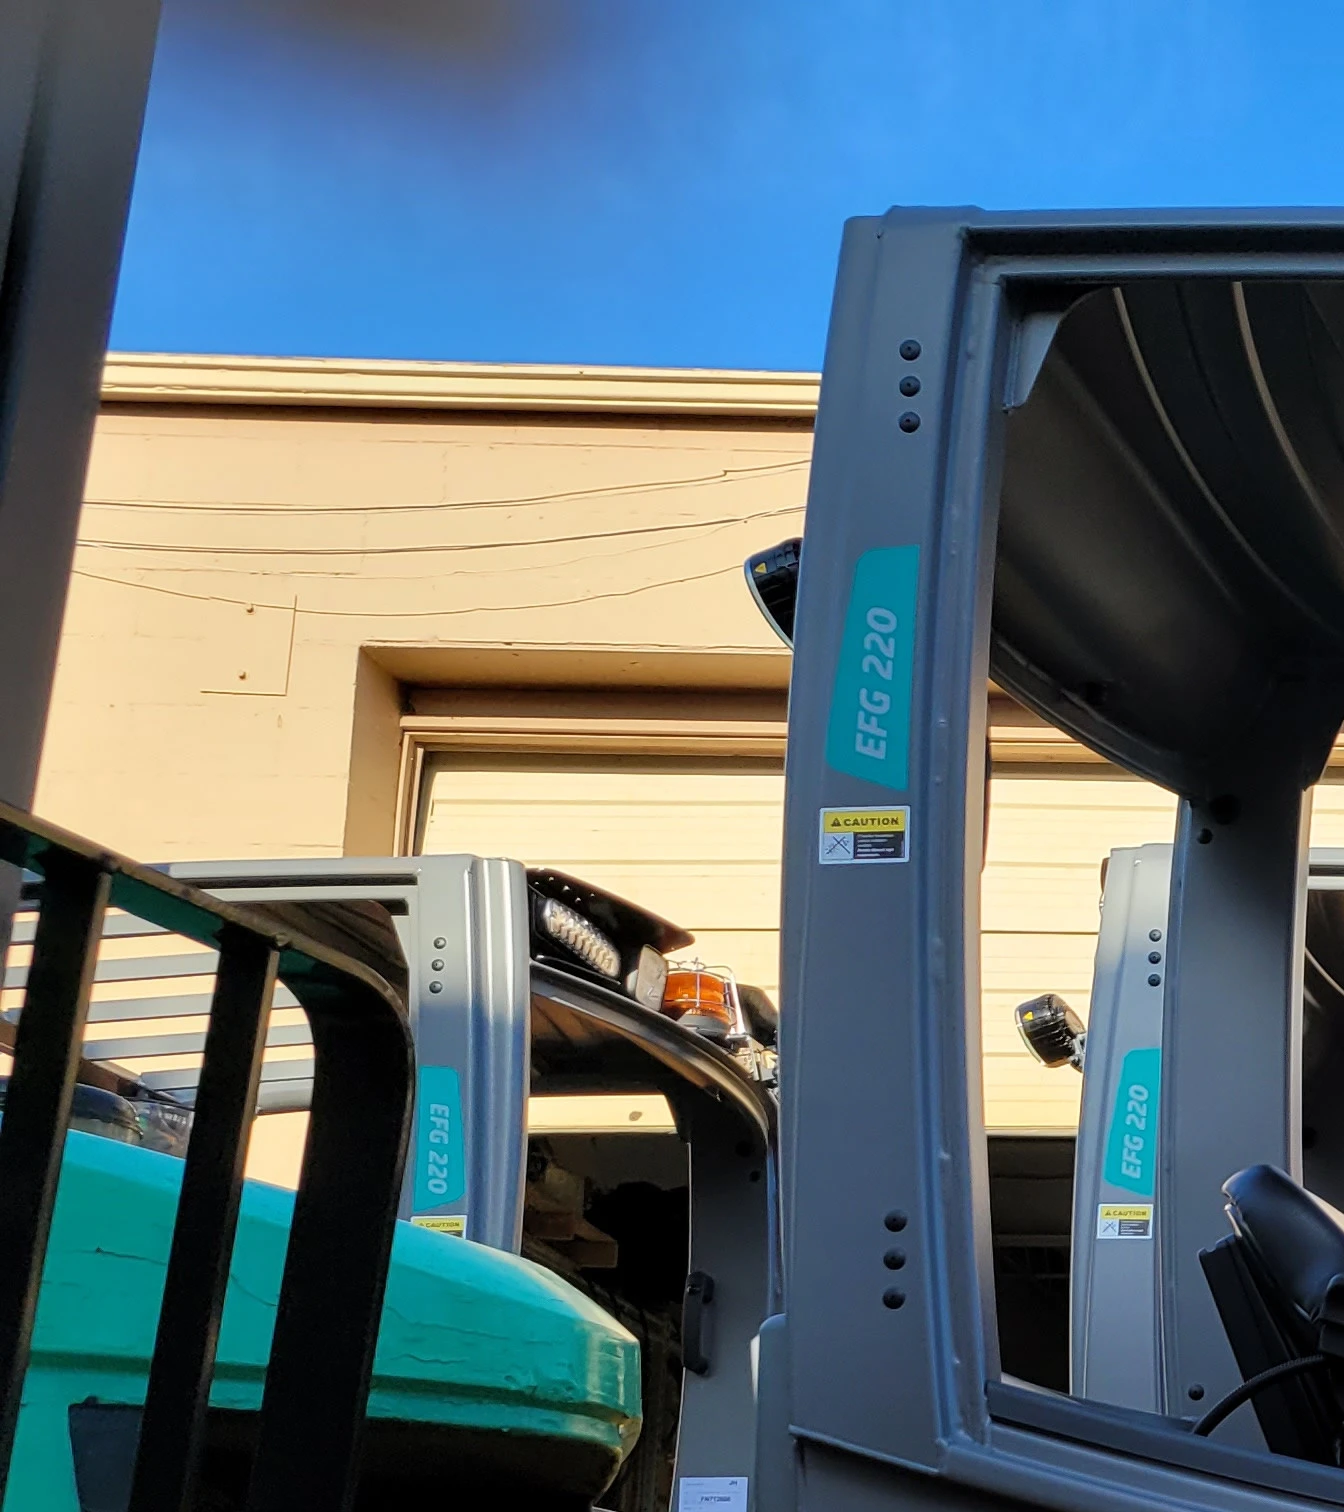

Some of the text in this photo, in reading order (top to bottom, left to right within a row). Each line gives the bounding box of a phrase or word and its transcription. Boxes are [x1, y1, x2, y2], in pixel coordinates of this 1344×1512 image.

[856, 607, 897, 759] EFG 220
[844, 818, 899, 826] CAUTION
[428, 1104, 449, 1195] EFG 220
[1121, 1085, 1149, 1179] EFG 220
